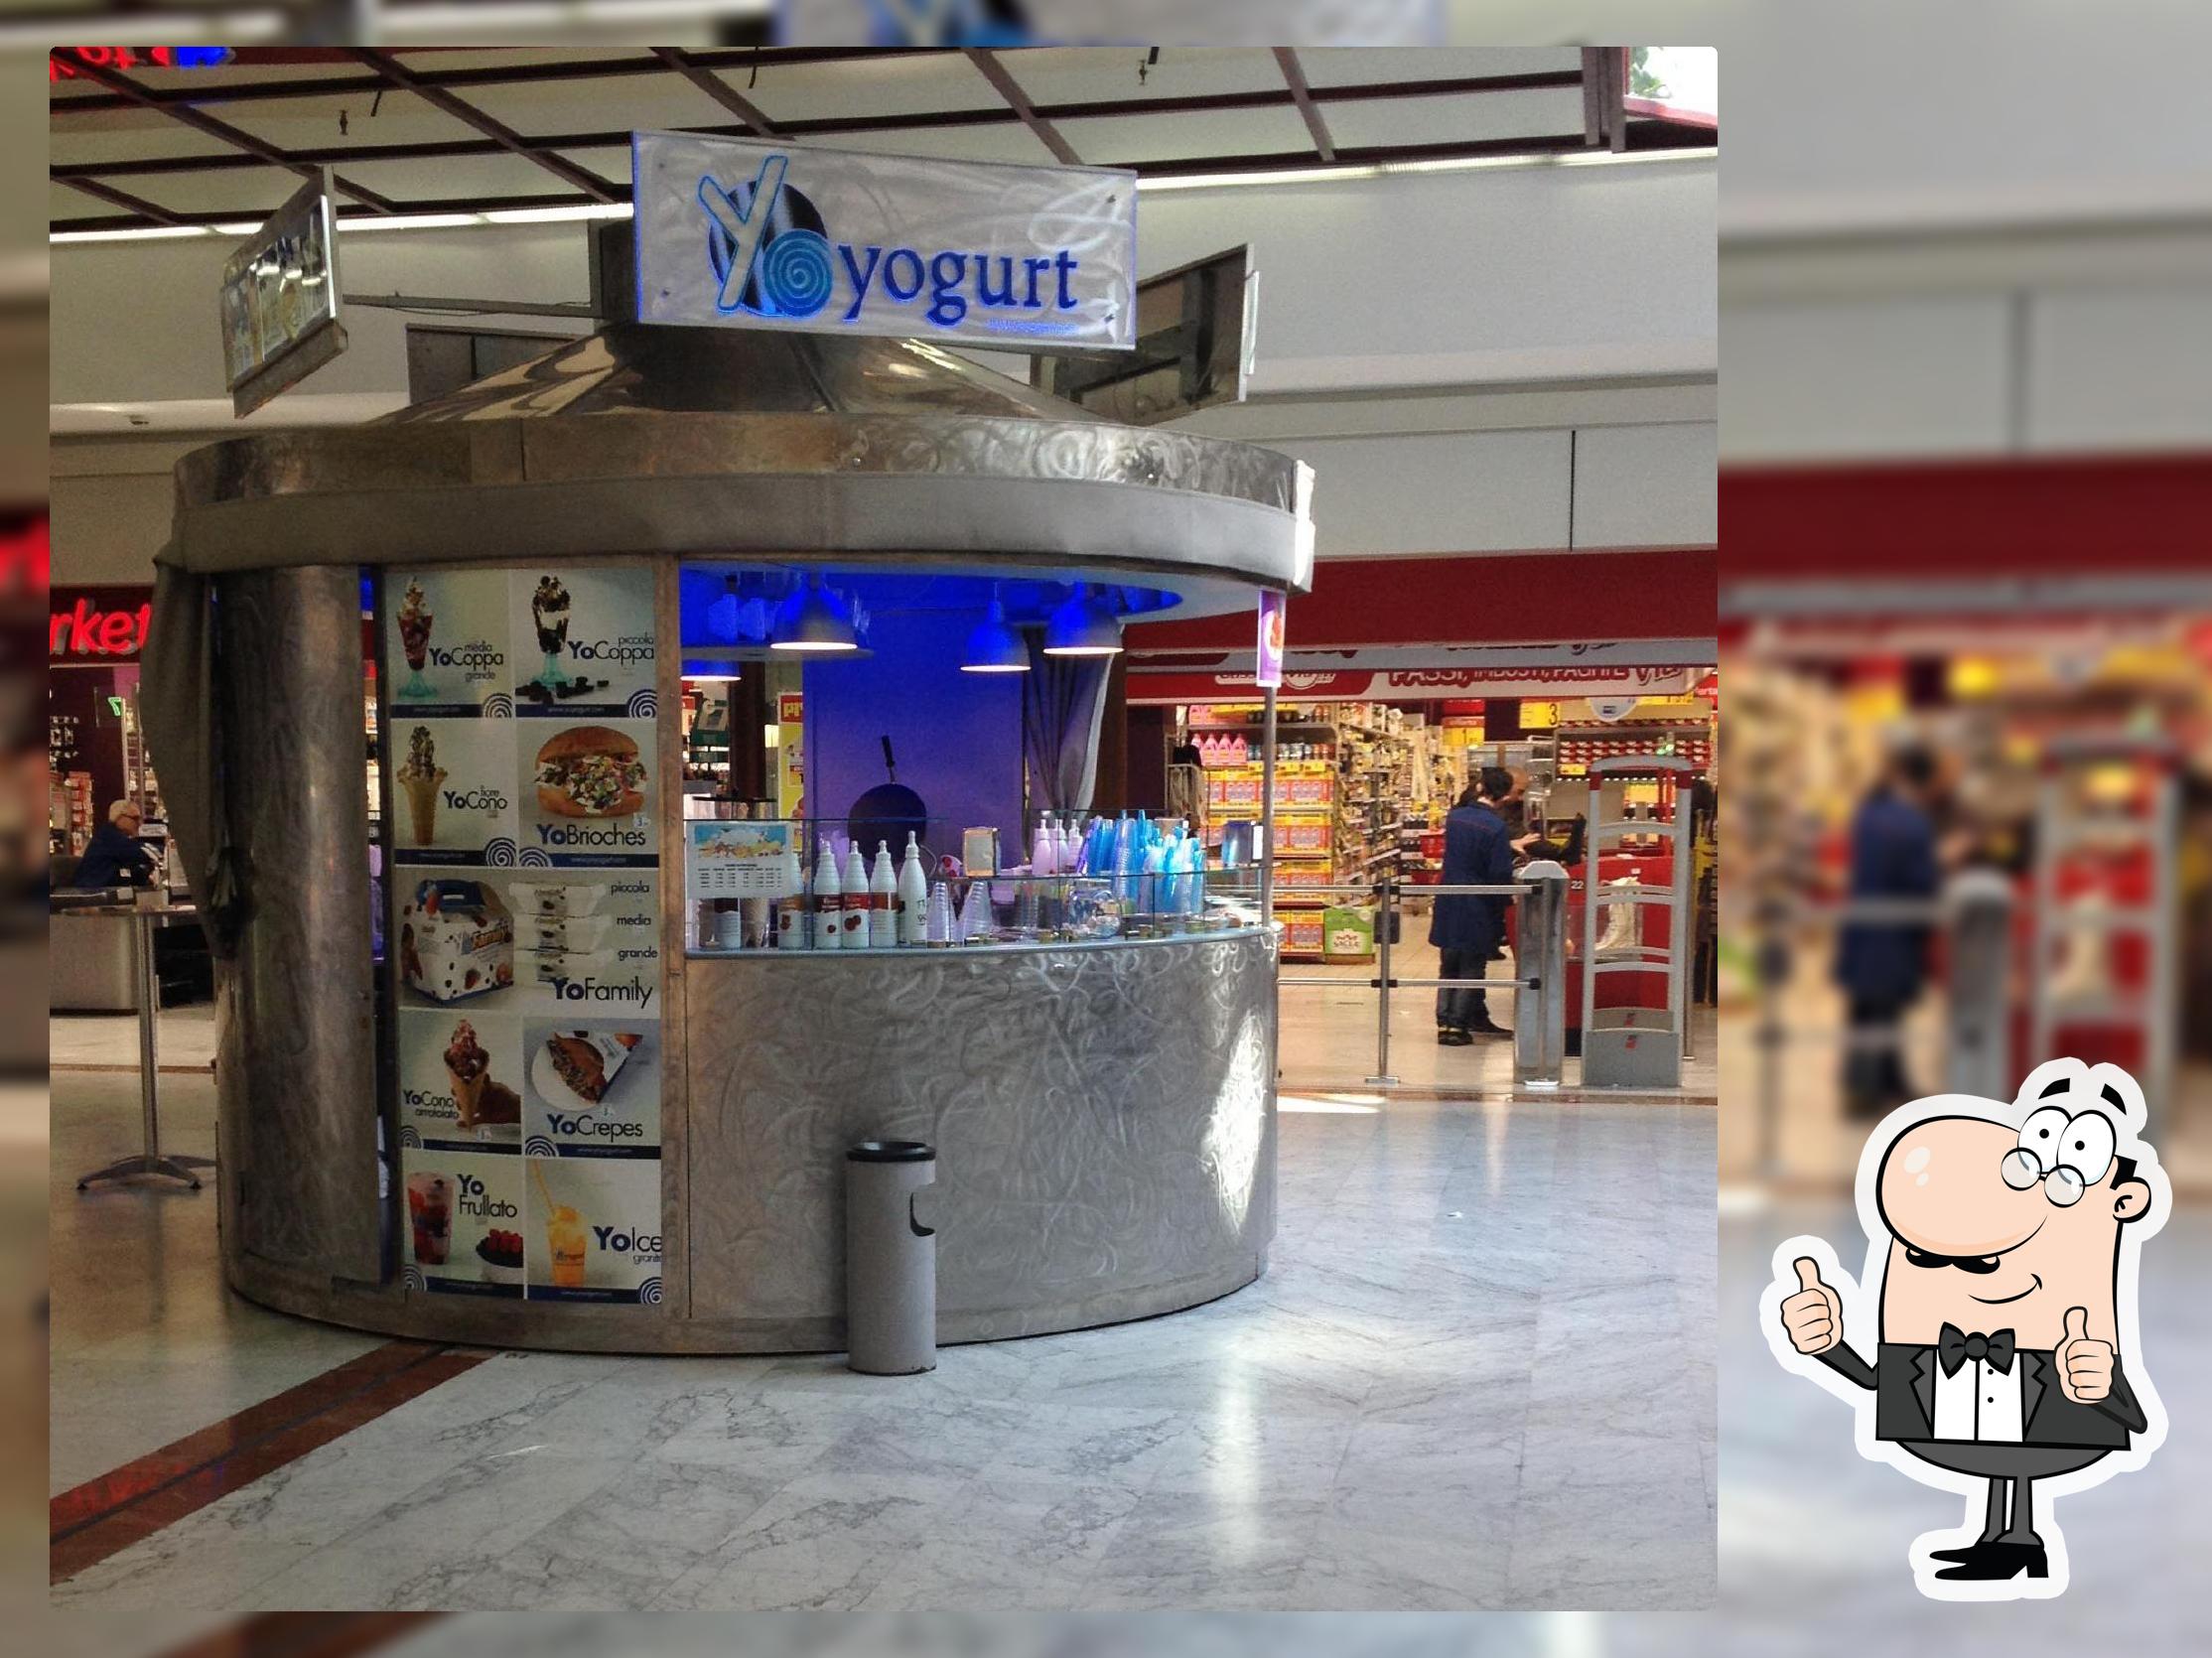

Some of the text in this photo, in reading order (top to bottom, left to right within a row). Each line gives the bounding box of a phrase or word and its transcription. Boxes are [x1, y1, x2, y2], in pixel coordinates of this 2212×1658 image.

[837, 242, 1078, 327] yogurt
[465, 640, 492, 652] media
[618, 632, 654, 645] piccola
[429, 646, 504, 670] YoCoppa
[568, 640, 655, 666] YoCoppa
[465, 670, 496, 682] grande
[1549, 704, 1559, 726] 3
[444, 790, 507, 810] YoCono
[537, 822, 646, 846] YoBrioches
[611, 881, 650, 896] piccola
[1571, 881, 1585, 890] 22
[617, 915, 651, 926] media
[618, 947, 658, 960] grande
[549, 976, 653, 1009] YoFamily
[402, 1090, 456, 1109] YoCono
[547, 1114, 643, 1143] YoCrepes
[457, 1174, 485, 1196] Yo
[459, 1194, 518, 1218] Frullato
[592, 1225, 662, 1252] YoIce
